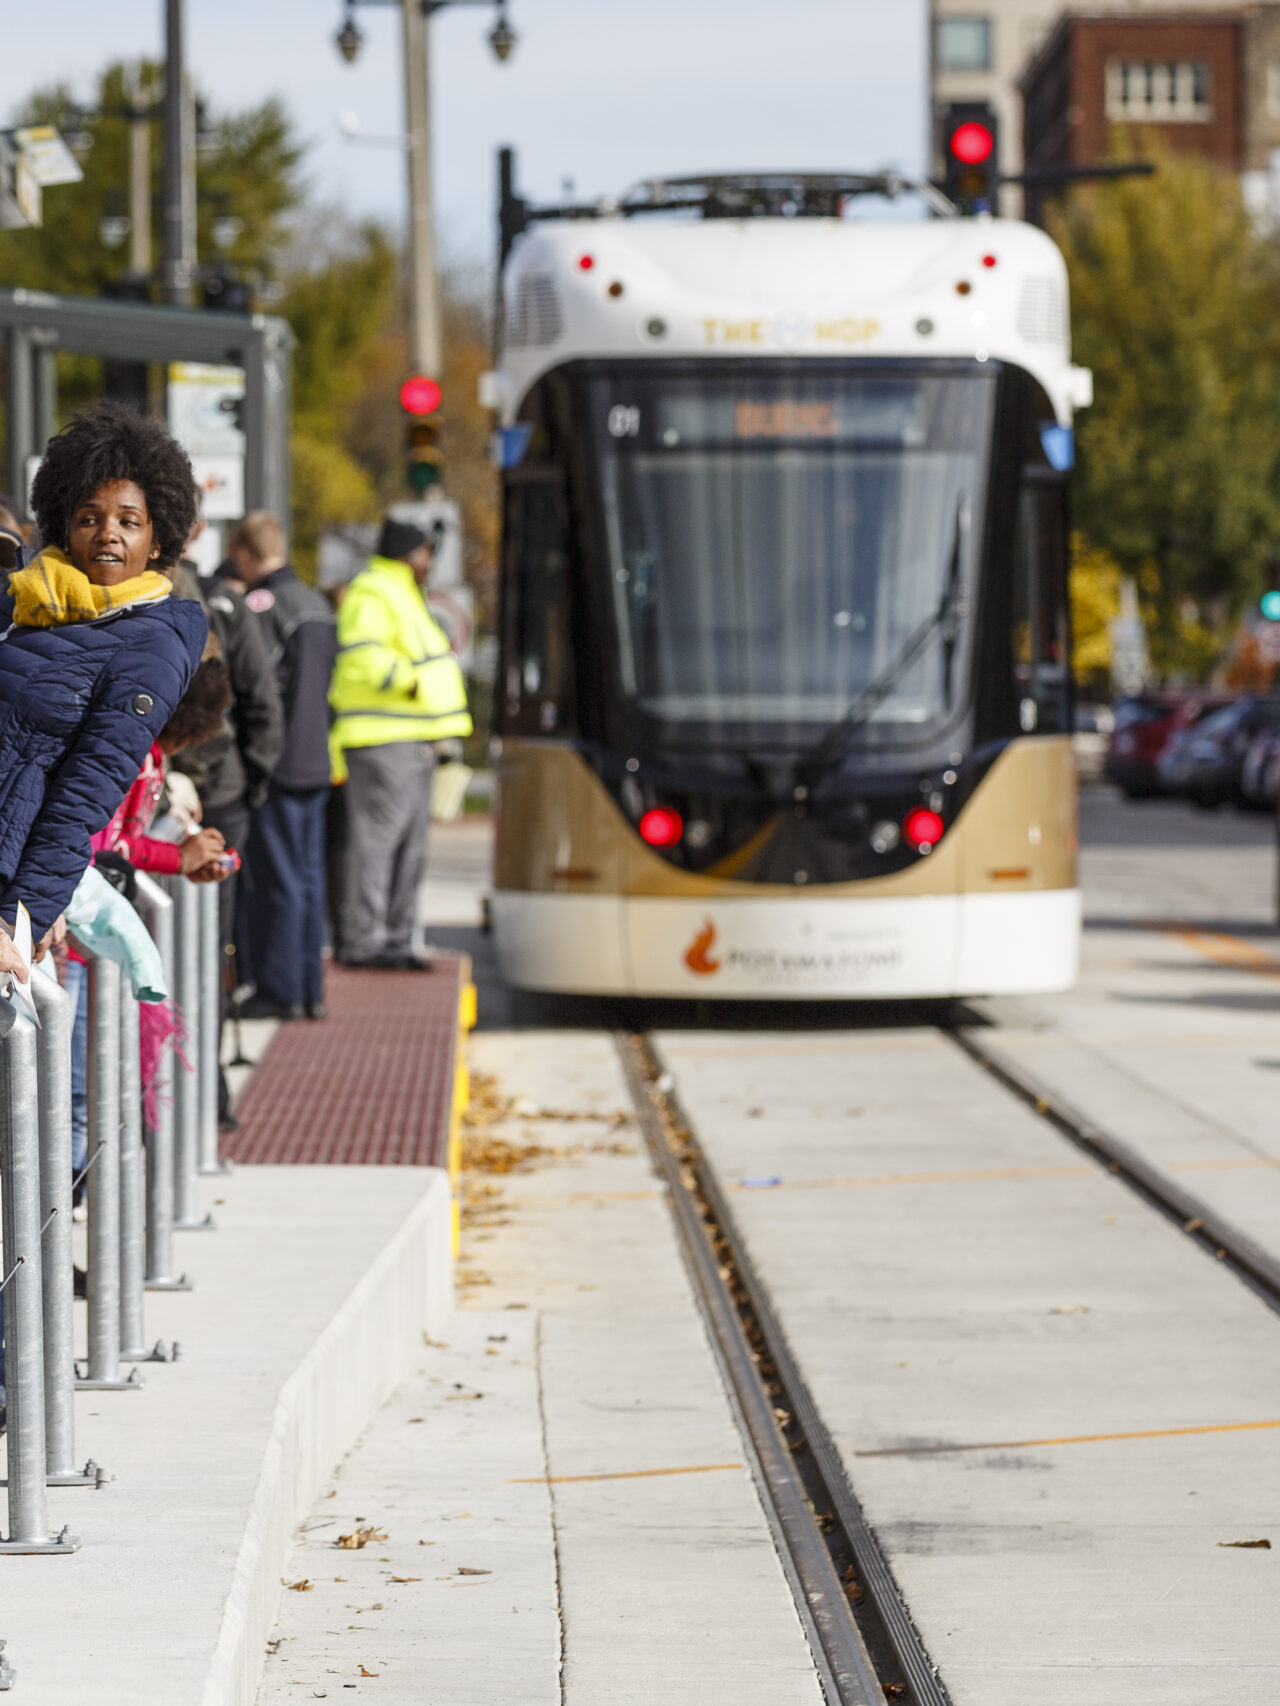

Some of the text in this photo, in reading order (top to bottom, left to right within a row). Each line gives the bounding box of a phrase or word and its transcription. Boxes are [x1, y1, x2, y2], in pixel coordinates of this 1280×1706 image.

[703, 318, 881, 343] THE HOP
[608, 404, 640, 437] 01
